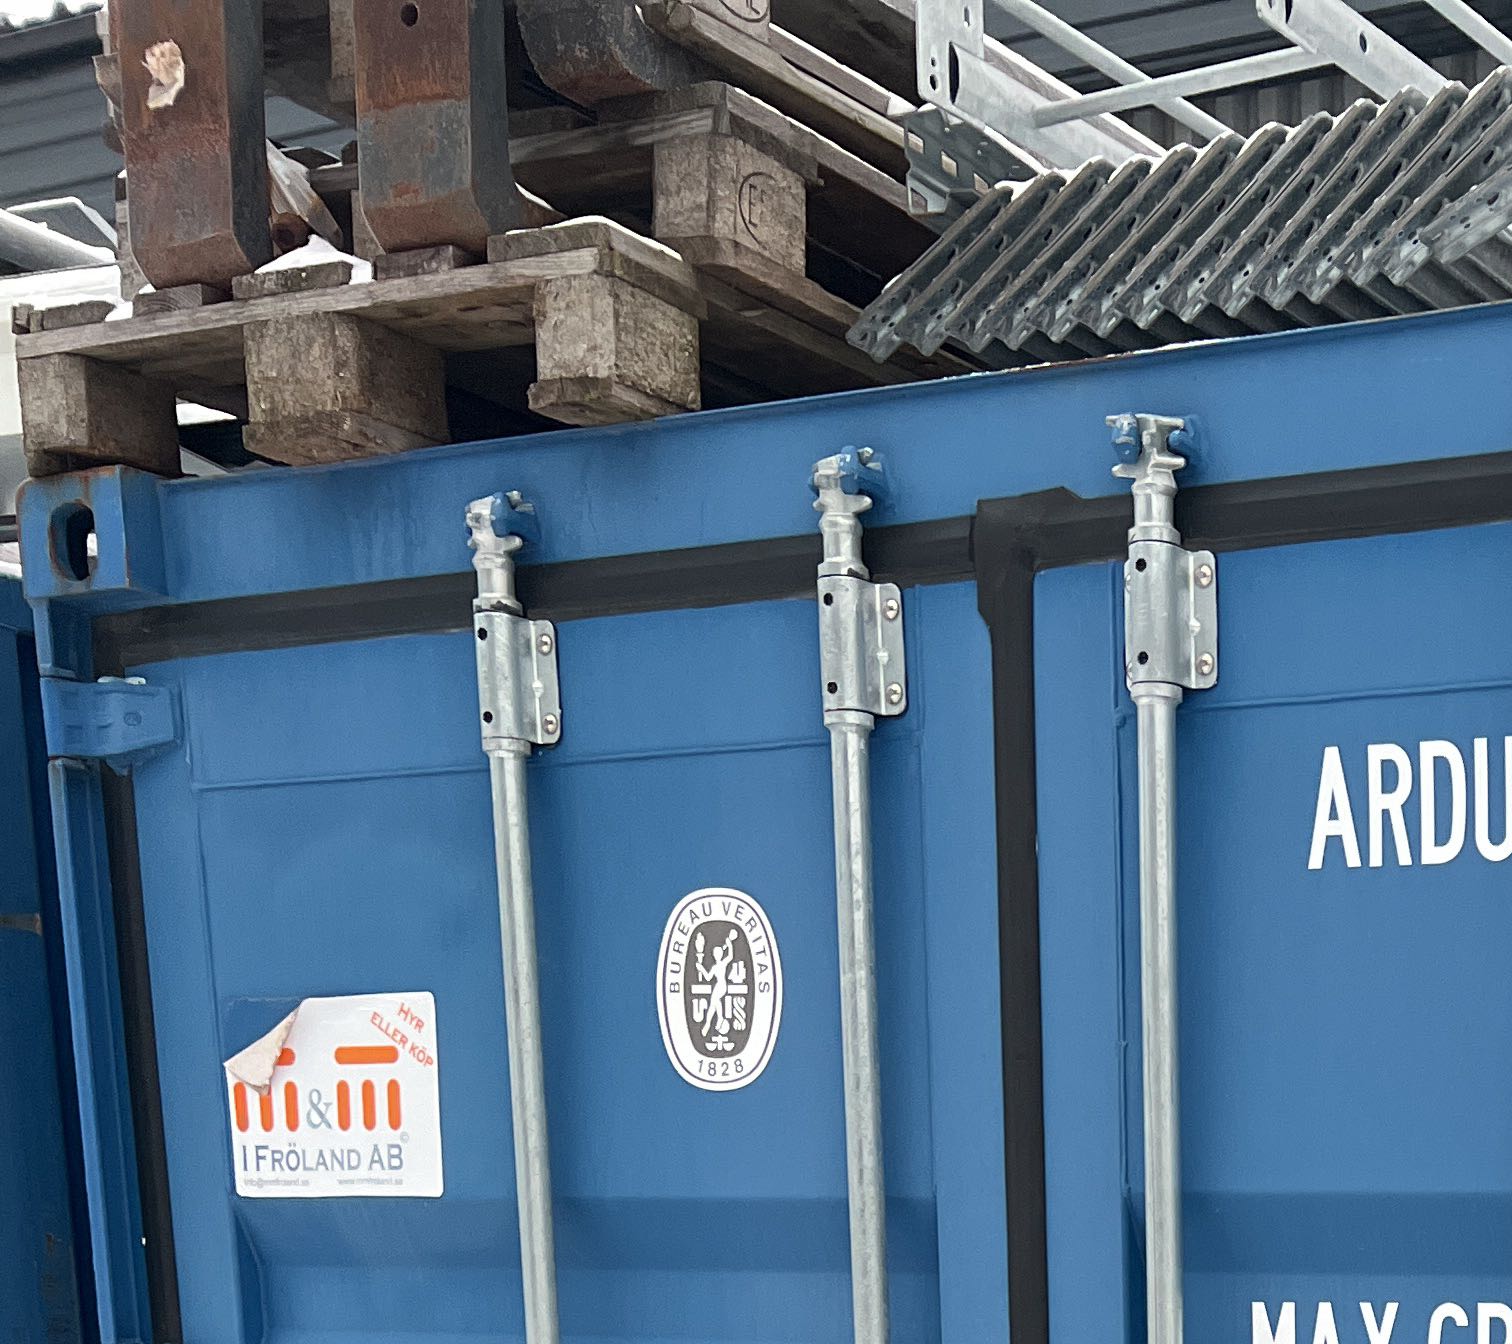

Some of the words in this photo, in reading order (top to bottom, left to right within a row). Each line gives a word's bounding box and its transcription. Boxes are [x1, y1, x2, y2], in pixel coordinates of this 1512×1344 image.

[669, 902, 713, 993] BUREAU
[721, 901, 770, 993] VERITAS
[397, 1002, 425, 1033] HYR
[370, 1011, 408, 1048] ELLER
[408, 1041, 434, 1068] KÖP
[697, 1059, 744, 1077] 1828
[254, 1142, 362, 1172] FRÖLAND
[367, 1144, 404, 1171] AB
